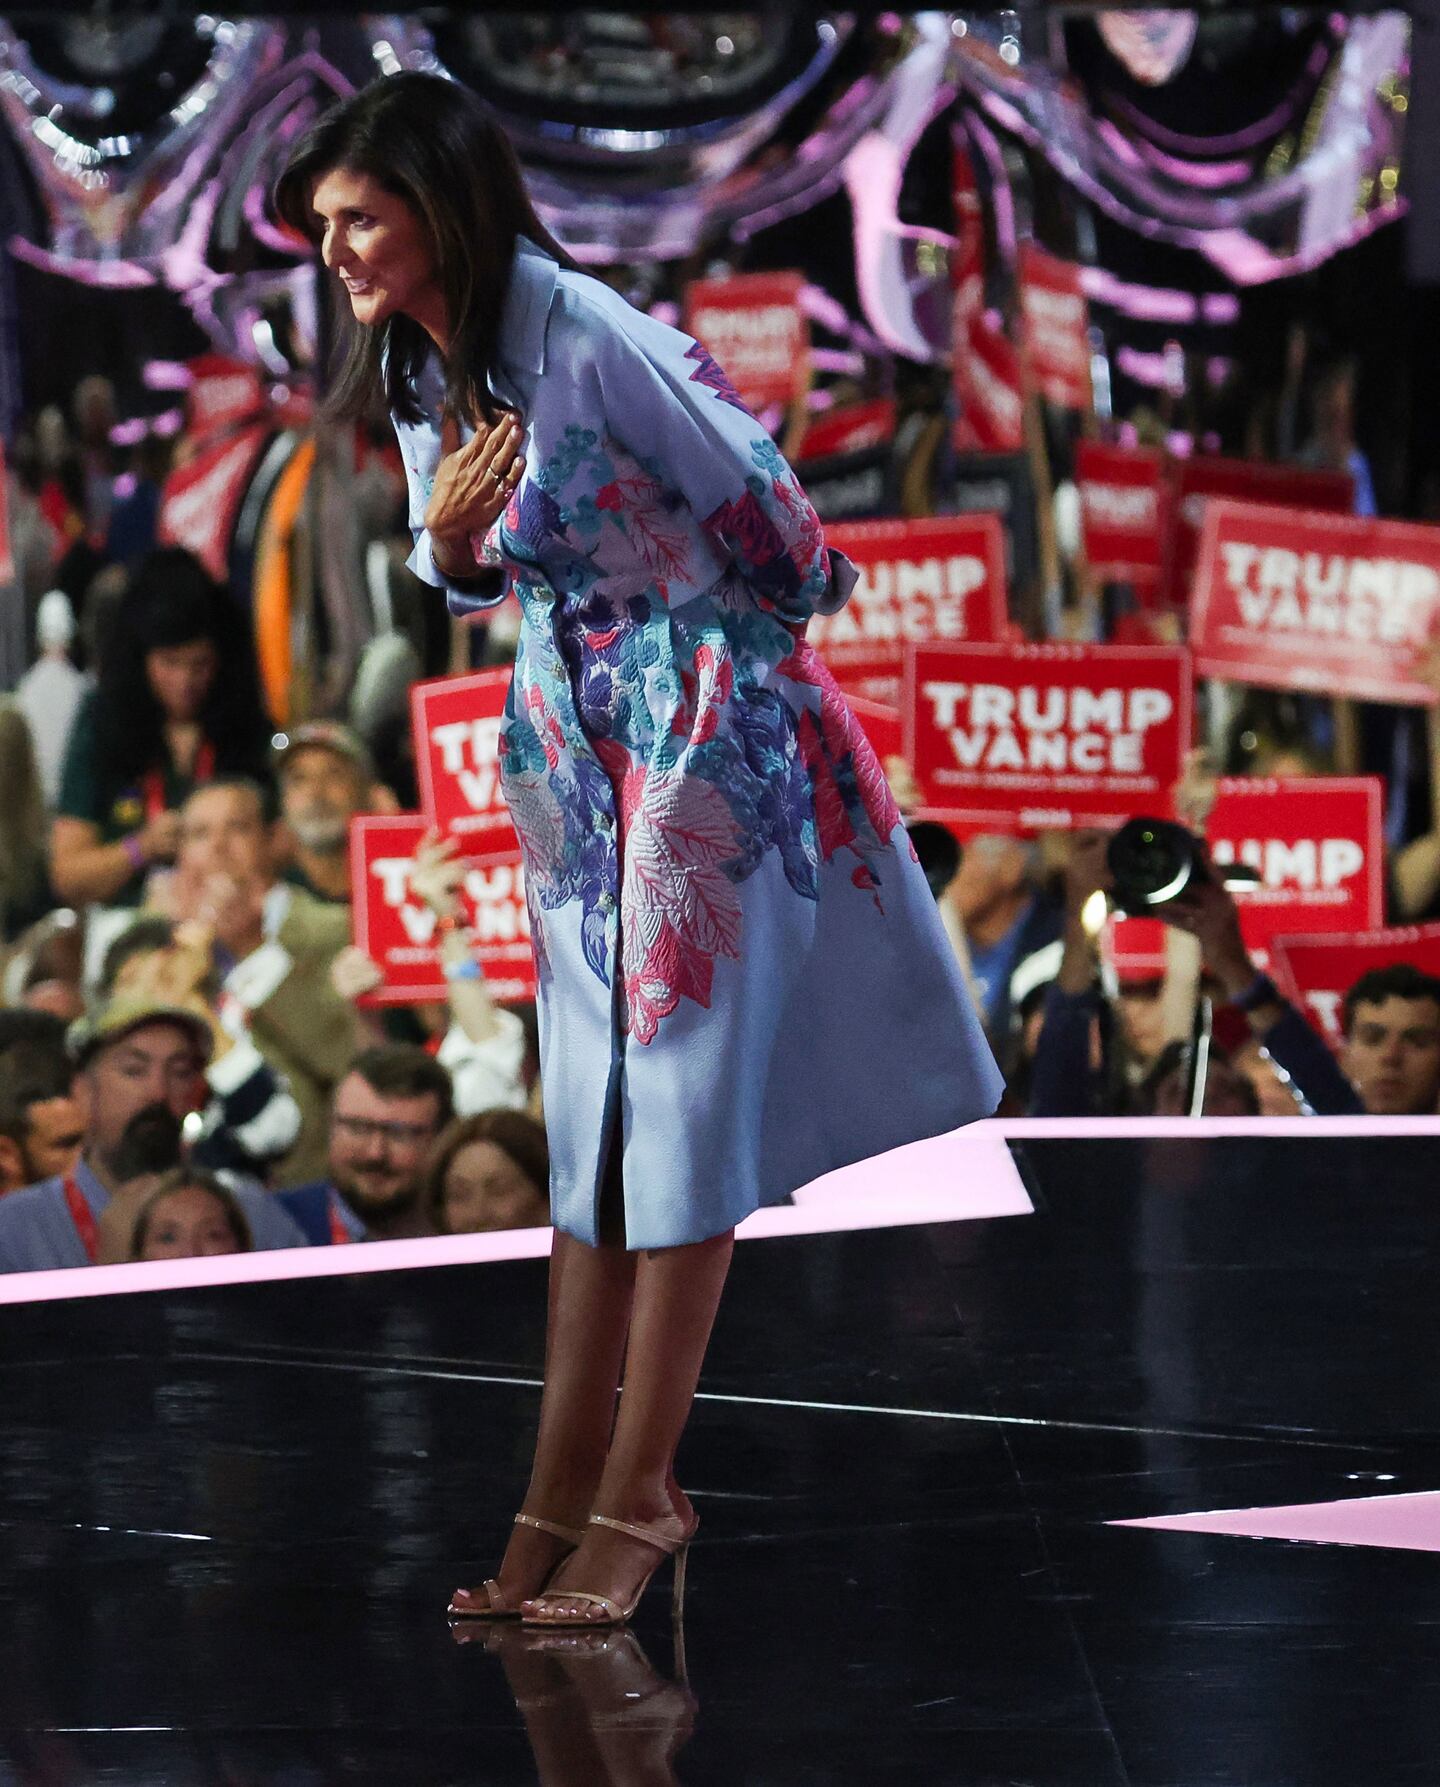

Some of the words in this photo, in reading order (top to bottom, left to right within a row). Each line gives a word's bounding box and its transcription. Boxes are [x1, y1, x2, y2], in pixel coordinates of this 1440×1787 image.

[853, 555, 987, 602] UMP
[1220, 541, 1438, 601] TRUMP
[923, 681, 1173, 732] TRUMP
[951, 728, 1145, 772] VANCE
